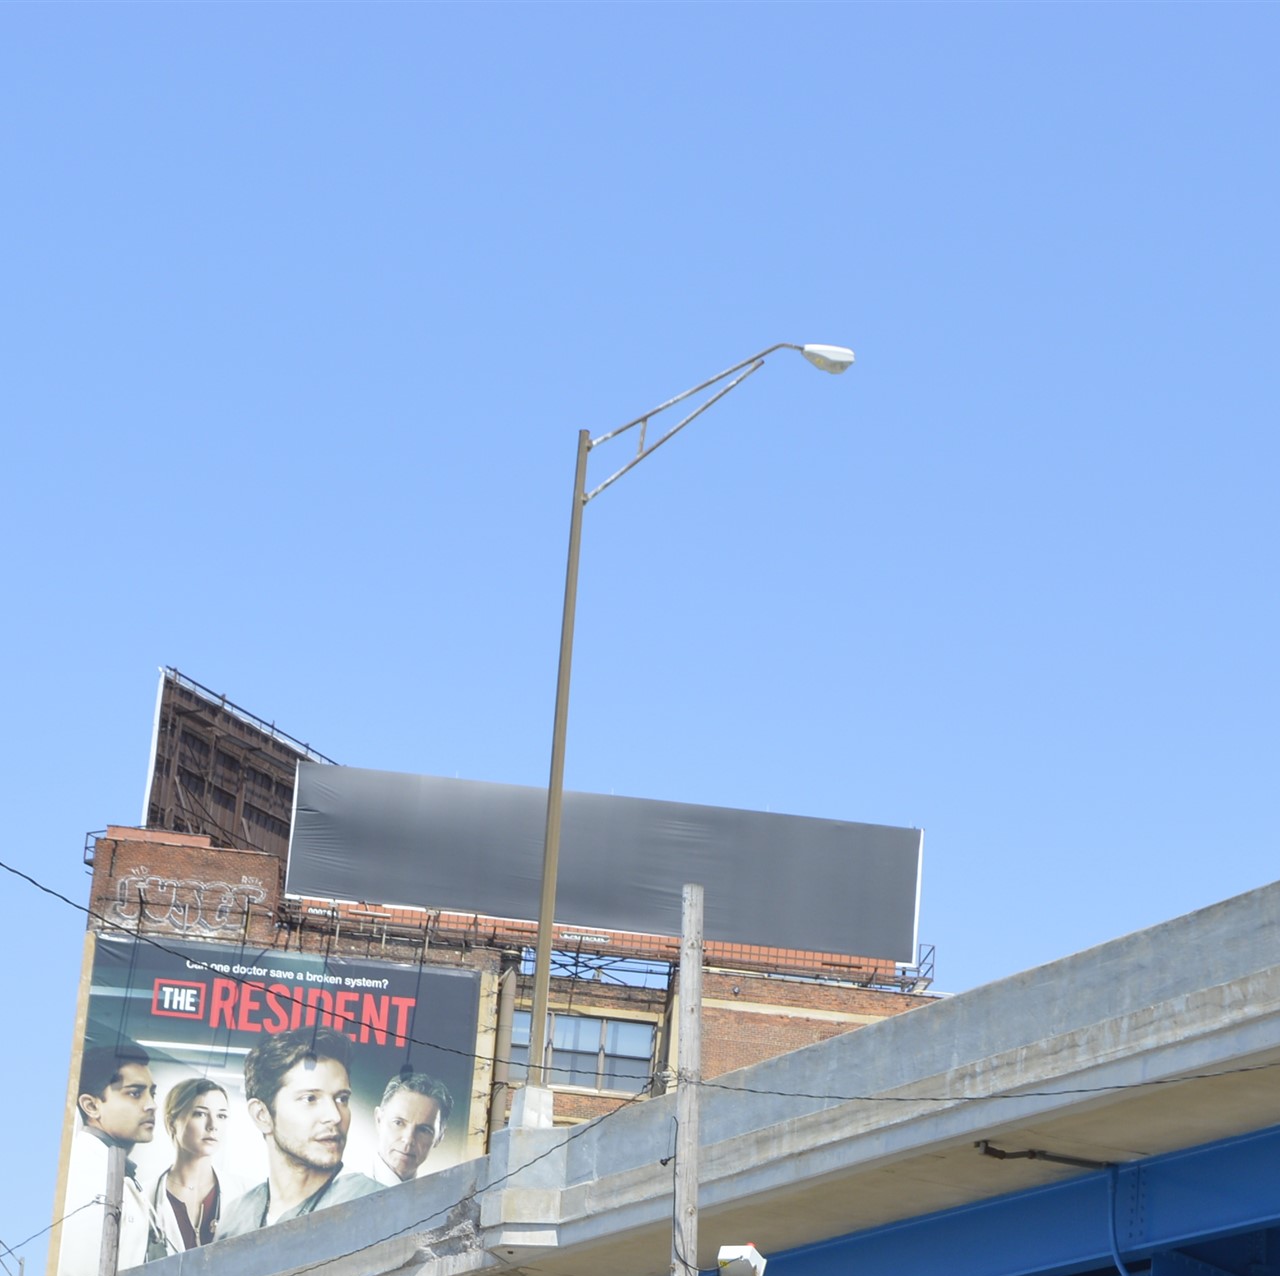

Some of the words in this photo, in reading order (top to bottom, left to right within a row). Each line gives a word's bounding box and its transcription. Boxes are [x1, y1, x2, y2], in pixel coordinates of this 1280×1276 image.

[210, 962, 229, 974] one
[232, 964, 267, 977] doctor
[269, 970, 294, 980] save
[296, 972, 304, 981] a
[306, 971, 342, 985] broken
[344, 976, 389, 989] system?
[162, 986, 197, 1013] THE
[208, 977, 417, 1048] RESIDENT
